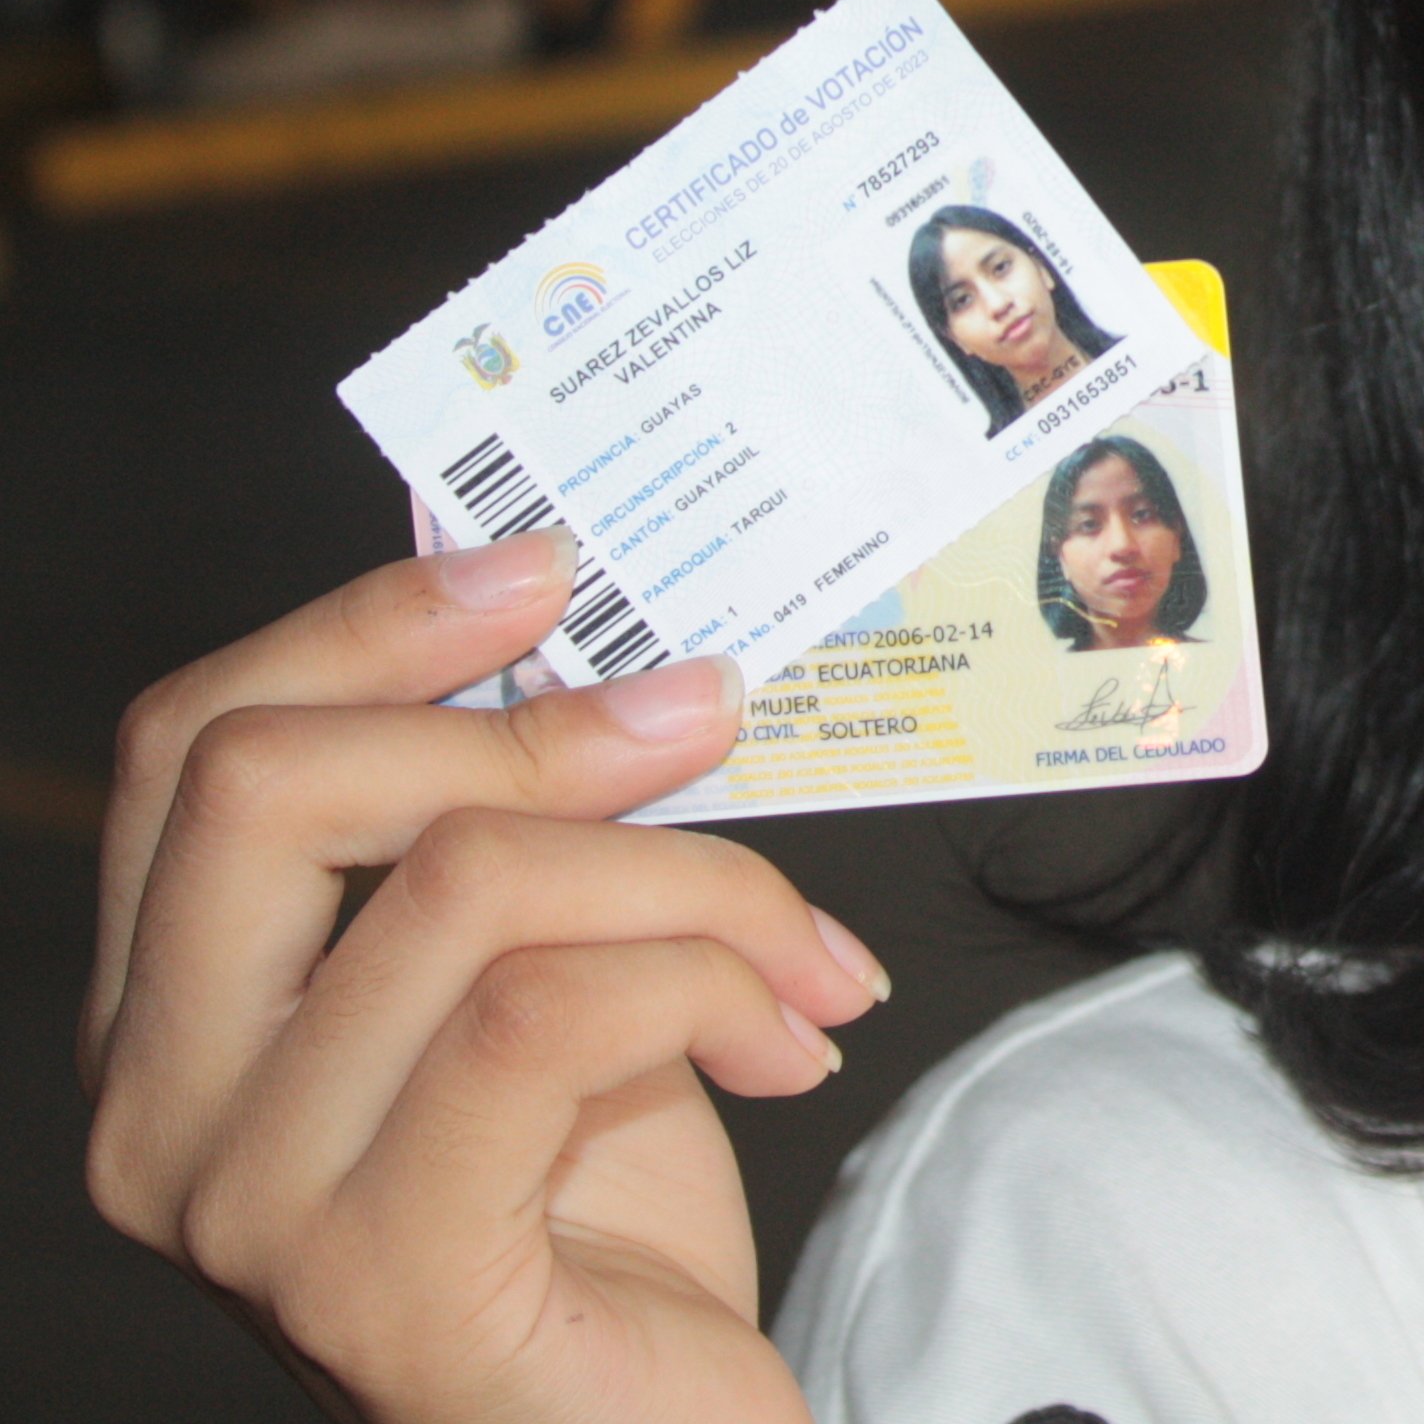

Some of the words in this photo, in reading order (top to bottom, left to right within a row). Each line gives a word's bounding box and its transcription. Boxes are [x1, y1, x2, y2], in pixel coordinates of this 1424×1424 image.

[624, 127, 778, 250] CERTIFICADO
[779, 107, 810, 136] de
[805, 16, 925, 110] VOTACIÓN
[652, 190, 746, 264] ELECCIONES
[744, 174, 768, 193] DE
[769, 156, 788, 176] 20
[788, 138, 811, 160] DE
[811, 93, 872, 144] AGOSTO
[872, 76, 897, 97] DE
[894, 49, 930, 80] 2023
[856, 131, 940, 198] 78527293
[550, 339, 627, 404] SUAREZ
[625, 265, 725, 347] ZEVALLOS
[724, 240, 758, 271] LIZ
[613, 301, 722, 385] VALENTINA
[557, 433, 640, 497] PROVINCIA:
[640, 384, 702, 434] GUAYAS
[1005, 444, 1022, 462] CC
[1037, 353, 1138, 436] 0931653851
[590, 432, 725, 537] CIRCUNSCRIPCIÓN:
[725, 421, 738, 435] 2
[609, 508, 675, 562] CANTÓN:
[674, 445, 760, 512] GUAYAQUIL
[641, 532, 733, 604] PARROQUIA:
[730, 488, 788, 536] TARQUI
[748, 620, 776, 642] No.
[773, 593, 807, 623] 0419
[813, 530, 889, 593] FEMENINO
[680, 616, 728, 654] ZONA:
[727, 605, 738, 618] 1
[817, 653, 971, 683] ECUATORIANA
[873, 621, 995, 649] 2006-02-14
[750, 694, 821, 718] MUJER
[753, 724, 800, 742] CIVIL
[819, 715, 918, 742] SOLTERO
[1036, 748, 1090, 767] FIRMA
[1096, 746, 1128, 763] DEL
[1133, 737, 1226, 760] CEDULADO
